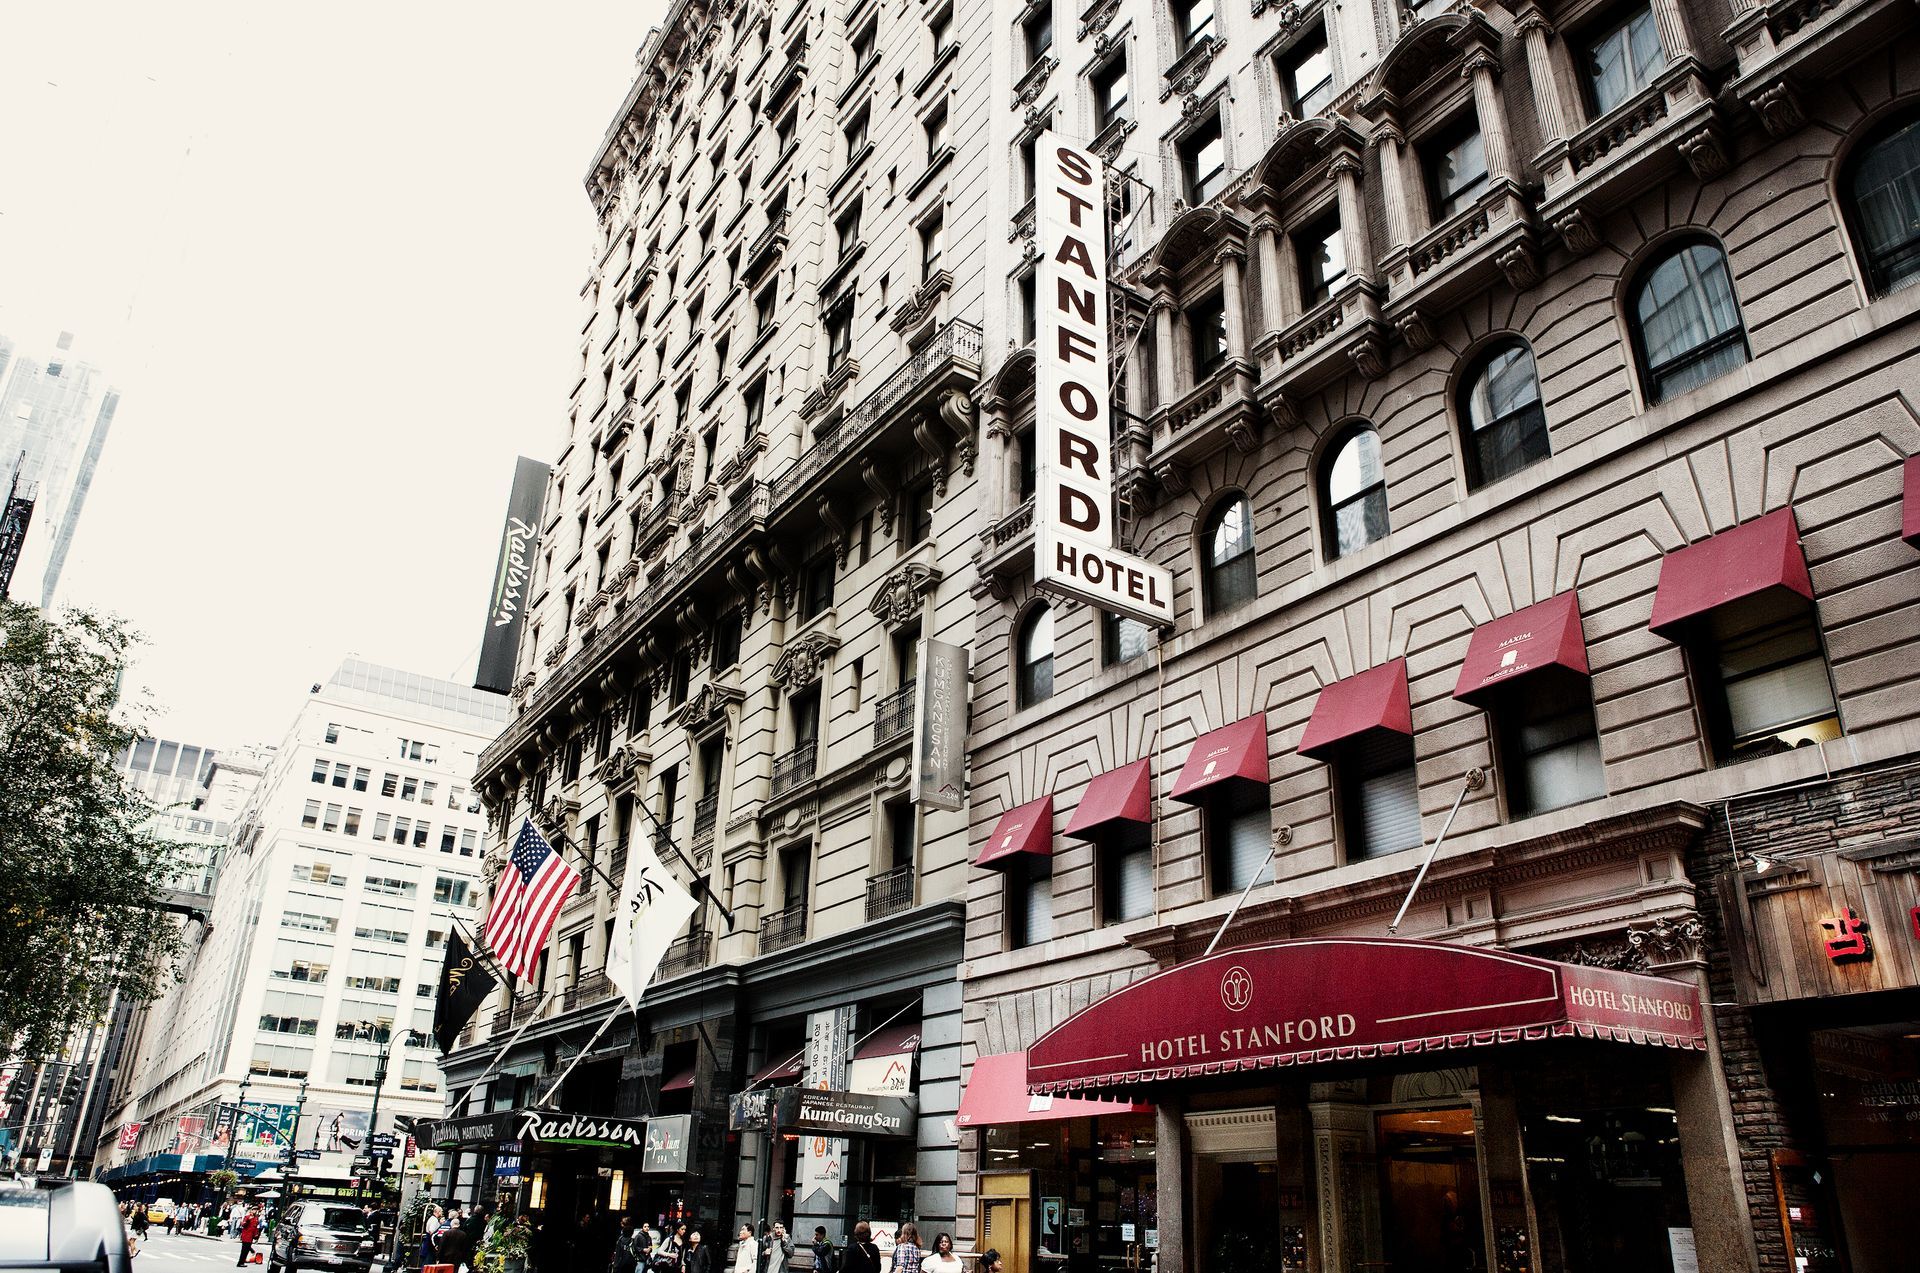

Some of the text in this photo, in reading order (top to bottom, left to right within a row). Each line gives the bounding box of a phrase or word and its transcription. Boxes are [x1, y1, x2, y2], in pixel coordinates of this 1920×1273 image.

[1055, 147, 1101, 533] STANFORD
[494, 517, 537, 626] Radisson
[1057, 542, 1165, 609] HOTEL
[1498, 631, 1532, 649] MAXIM
[930, 656, 945, 769] KUMGANGSAN
[1570, 985, 1692, 1021] HOTEL STANFORD
[1140, 1013, 1357, 1063] HOTEL STANFORD
[802, 1099, 874, 1110] JAPANESE RESTAURANT
[803, 1094, 829, 1102] KOREAN
[517, 1112, 641, 1145] Radisson
[799, 1105, 901, 1129] KumGangSan
[430, 1122, 460, 1147] Radisson
[462, 1123, 494, 1140] MARTINIQUE
[656, 1154, 668, 1164] SPA
